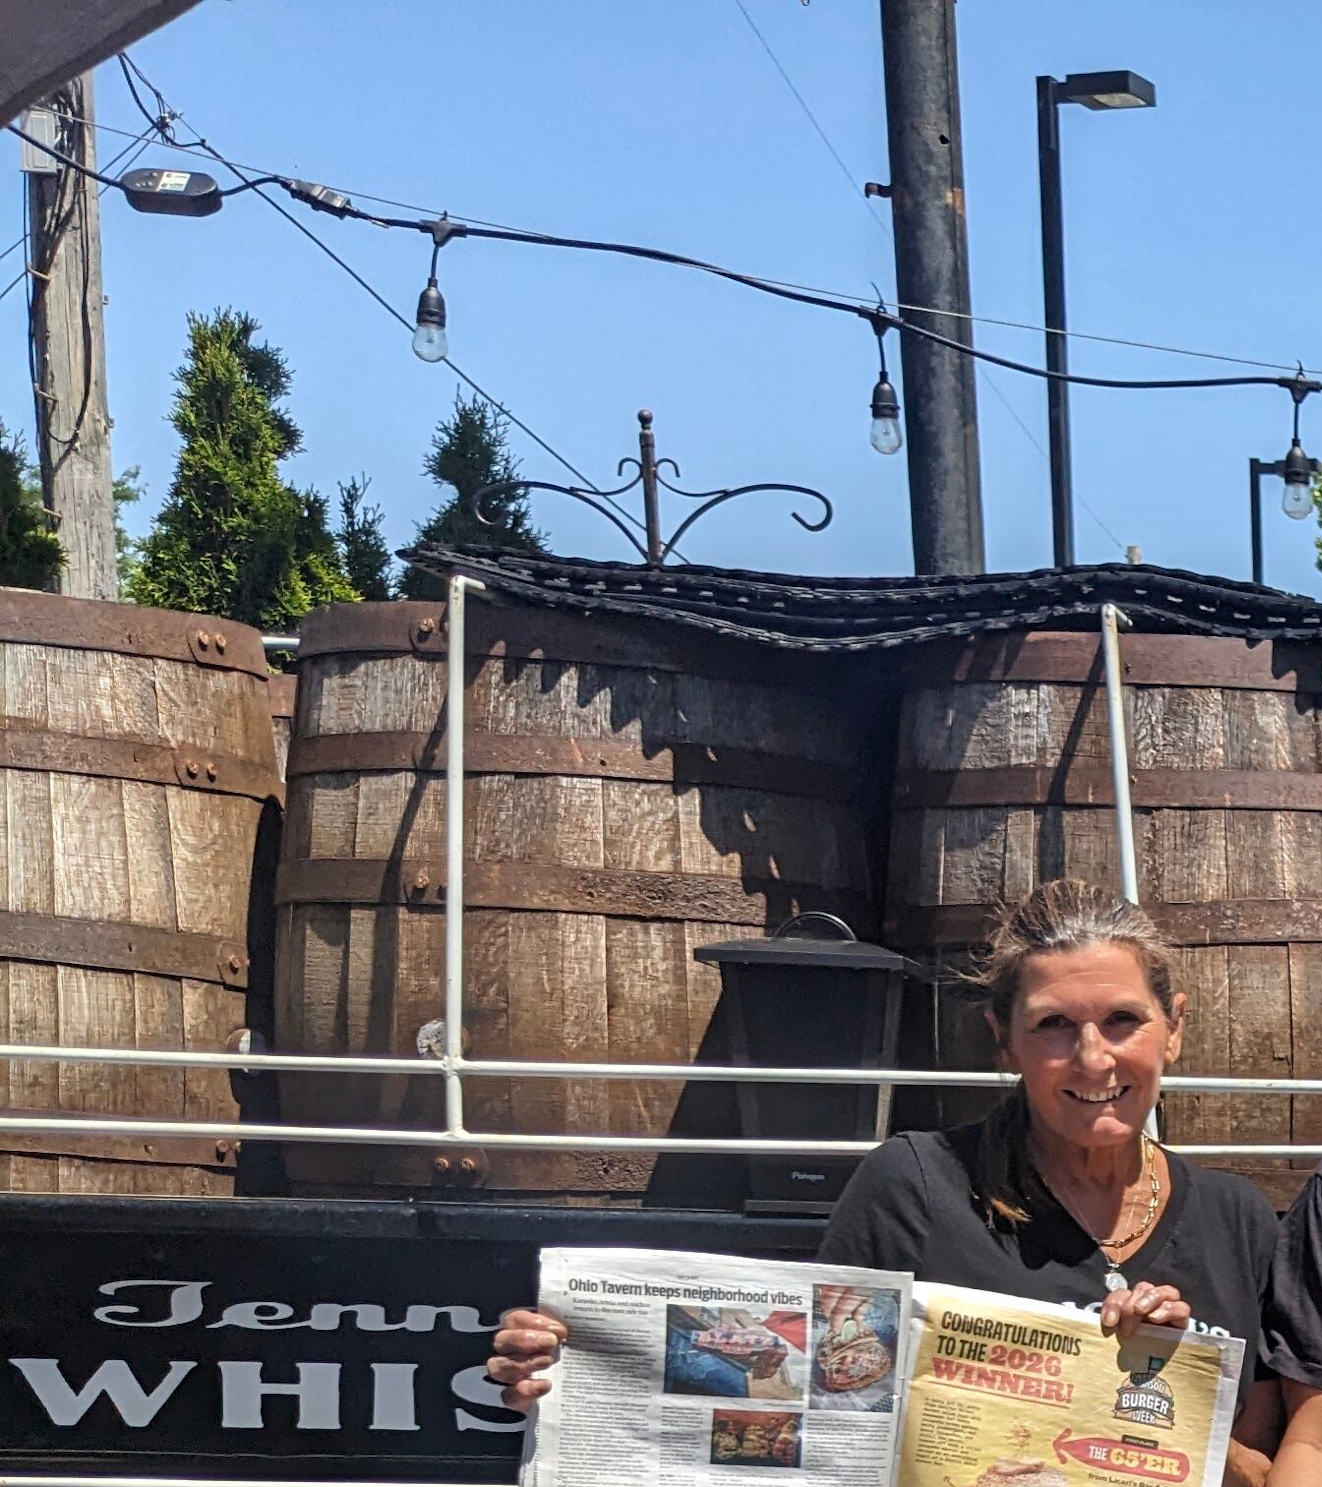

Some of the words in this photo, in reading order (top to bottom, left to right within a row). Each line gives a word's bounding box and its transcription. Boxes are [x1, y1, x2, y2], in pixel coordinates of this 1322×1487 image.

[94, 1279, 502, 1333] Tenn
[569, 1278, 598, 1293] Ohio
[600, 1280, 643, 1296] Tavern
[643, 1282, 681, 1298] keeps
[683, 1286, 769, 1304] neighborhood
[771, 1291, 803, 1306] vibes
[941, 1311, 1082, 1356] CONGRATULATIONS
[937, 1335, 956, 1355] TO
[959, 1339, 987, 1362] THE
[988, 1344, 1062, 1377] 2026
[8, 1358, 527, 1433] WHIS
[931, 1357, 1074, 1403] WINNER!
[1122, 1394, 1169, 1414] BURGER
[1133, 1410, 1157, 1424] WEEK
[1088, 1473, 1107, 1481] from
[1089, 1445, 1108, 1460] THE
[1110, 1448, 1181, 1476] 65'ER
